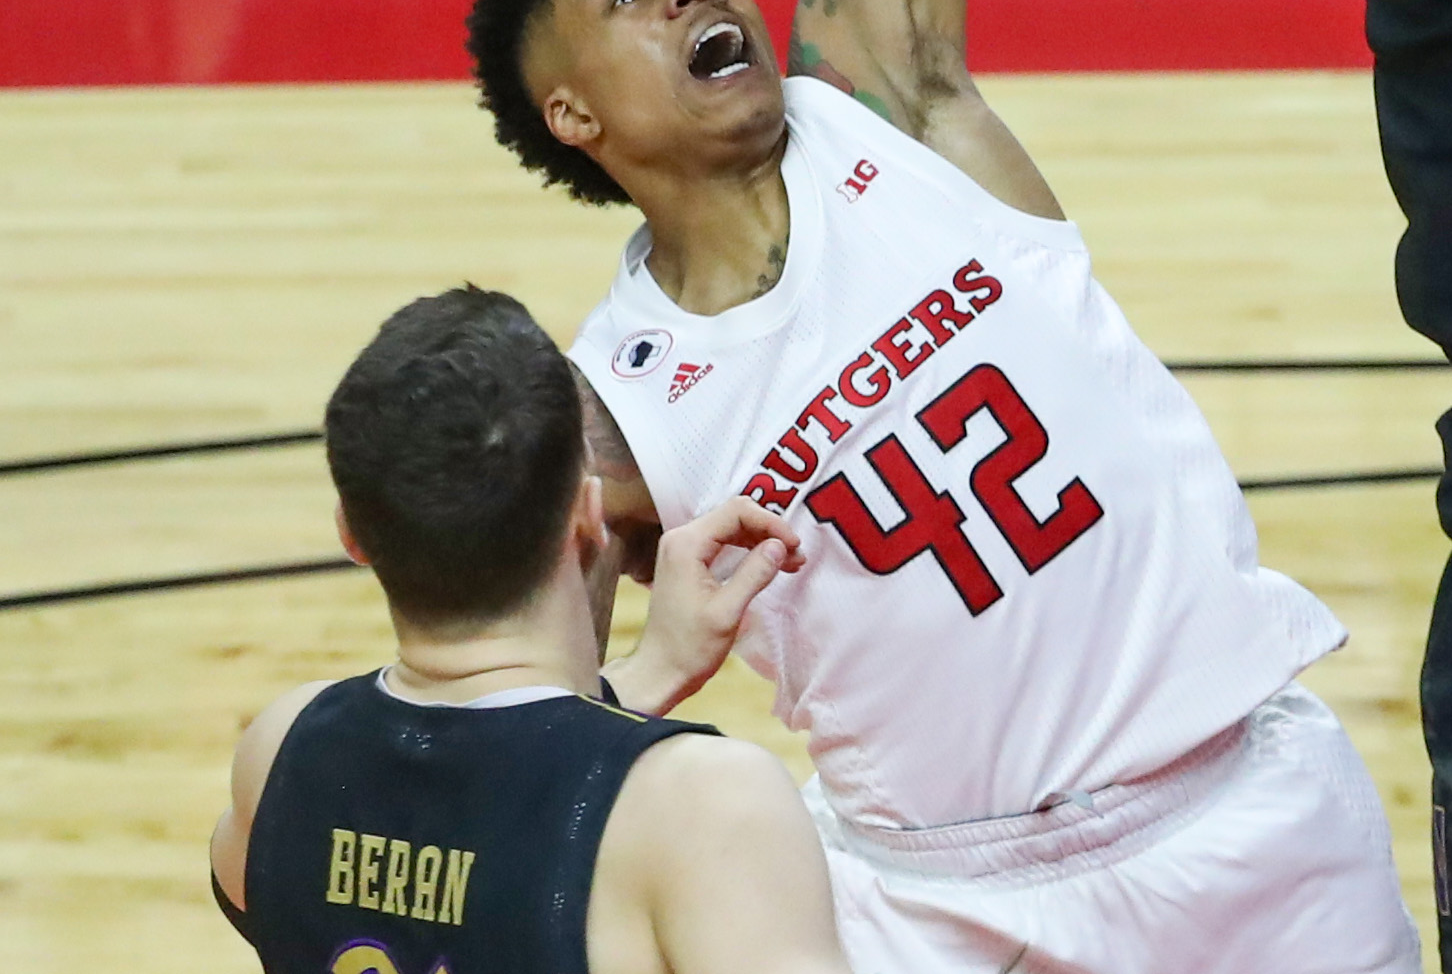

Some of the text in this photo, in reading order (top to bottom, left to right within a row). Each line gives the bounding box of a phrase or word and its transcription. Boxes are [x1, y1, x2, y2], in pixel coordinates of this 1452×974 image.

[668, 362, 714, 403] adidas
[740, 258, 1003, 516] RUTGERS
[804, 362, 1105, 618] 42
[326, 828, 476, 926] BERAN
